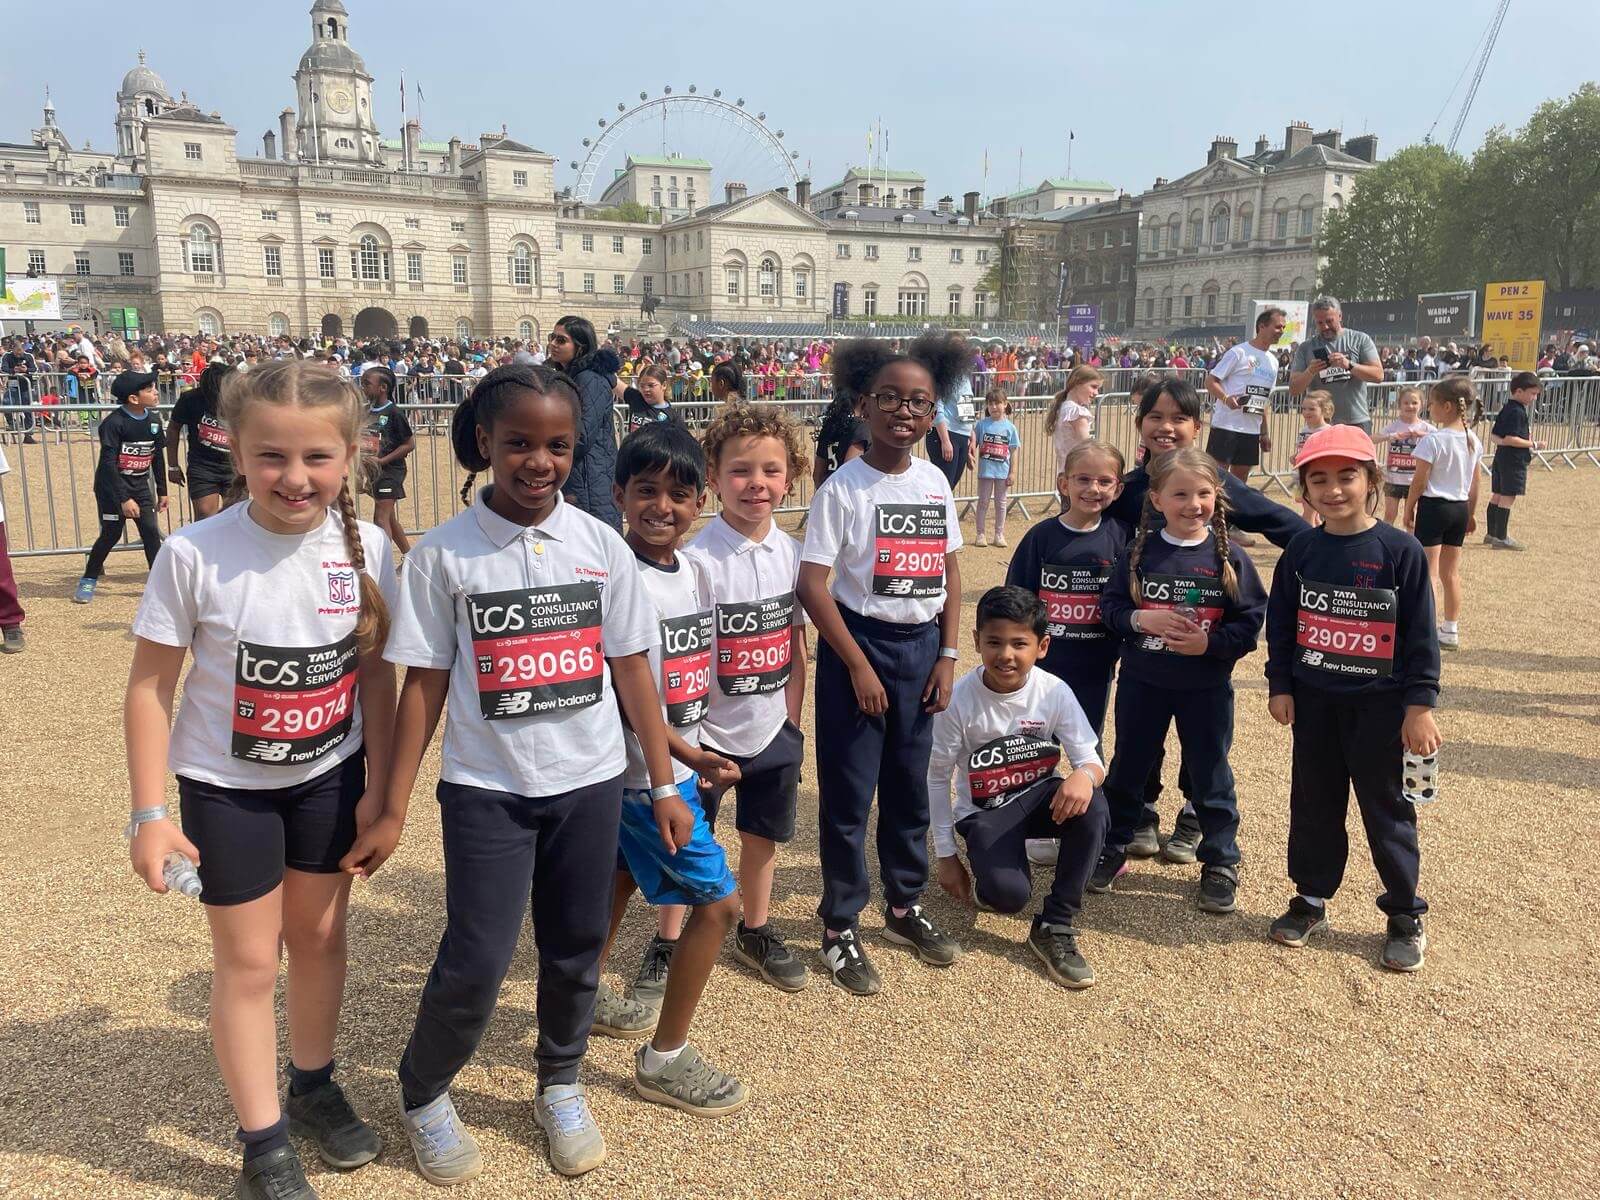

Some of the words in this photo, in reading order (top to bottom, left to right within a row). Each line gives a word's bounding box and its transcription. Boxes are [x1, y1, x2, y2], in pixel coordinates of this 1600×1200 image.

[1500, 286, 1519, 296] PEN
[1520, 286, 1528, 295] 2
[1427, 306, 1459, 316] WARM-UP
[1487, 311, 1513, 321] WAVE
[1518, 310, 1534, 321] 35
[1434, 316, 1451, 324] AREA
[201, 415, 218, 427] tcs
[207, 432, 228, 443] 2915
[122, 443, 140, 455] tcs
[828, 441, 839, 470] 5
[880, 509, 917, 534] tcs
[920, 527, 944, 535] SERVICES
[880, 554, 890, 562] 37
[894, 552, 945, 572] 29075
[1041, 568, 1068, 590] tcs
[1142, 576, 1170, 600] tcs
[1173, 588, 1223, 597] CONTANCY
[1333, 590, 1357, 599] TATA
[528, 593, 562, 604] TATA
[1300, 583, 1329, 611] tcs
[318, 607, 345, 615] Primary
[530, 599, 599, 616] CONSULTANCY
[761, 602, 781, 612] TATA
[1331, 606, 1368, 617] SERVICES
[1332, 599, 1391, 611] CONSULTANCY
[471, 601, 525, 634] tcs
[531, 614, 578, 629] SERVICES
[718, 609, 758, 634] tcs
[762, 617, 788, 630] SERVICES
[664, 625, 699, 653] tcs
[1081, 631, 1105, 639] balanc
[1308, 626, 1377, 653] 29079
[306, 646, 358, 674] CONSULTANCY
[307, 649, 338, 663] TATA
[720, 654, 731, 663] 37
[737, 639, 791, 670] 29067
[241, 649, 300, 686] tcs
[480, 662, 492, 673] 37
[498, 647, 594, 683] 29066
[1323, 662, 1340, 670] new
[1341, 663, 1378, 675] balance
[305, 665, 344, 686] SERVICES
[670, 677, 680, 687] 37
[685, 666, 710, 695] 290
[760, 683, 776, 691] new
[533, 700, 556, 712] new
[558, 692, 597, 708] balance
[239, 707, 254, 718] 37
[261, 692, 347, 733] 29074
[290, 749, 315, 762] new
[315, 733, 345, 756] balance
[1004, 738, 1026, 747] TATA
[970, 747, 1004, 769] tcs
[1007, 751, 1039, 762] SERVICES
